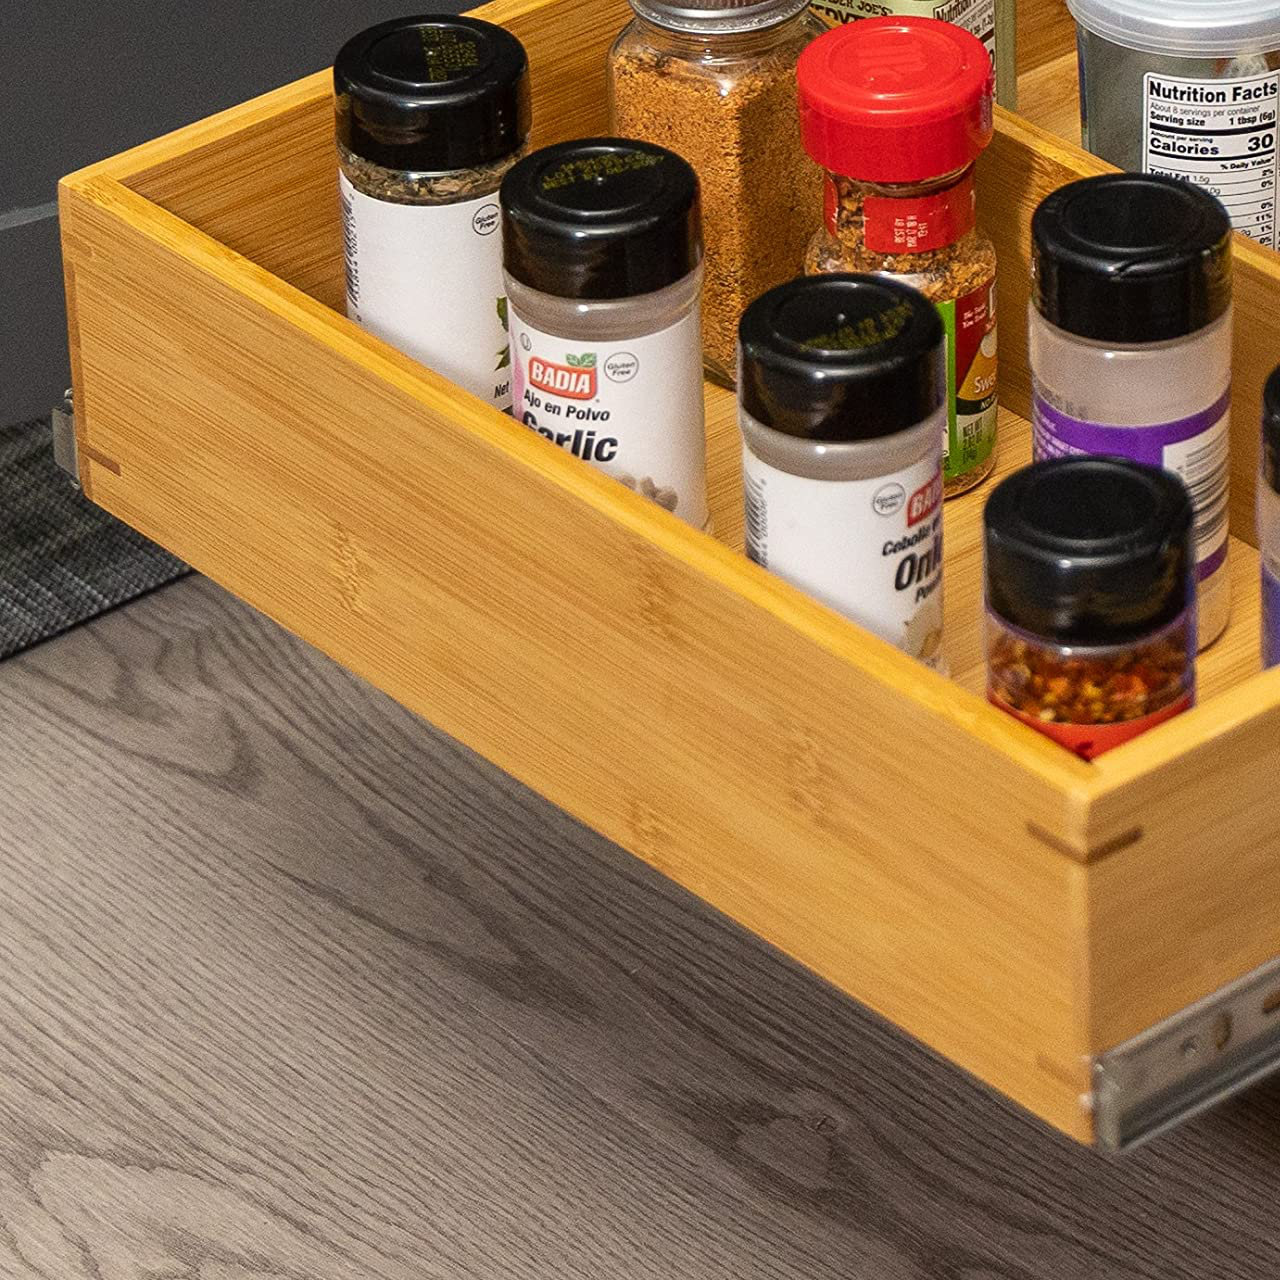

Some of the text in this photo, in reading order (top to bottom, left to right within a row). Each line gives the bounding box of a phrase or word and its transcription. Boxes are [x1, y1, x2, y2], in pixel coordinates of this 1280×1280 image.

[1149, 80, 1278, 103] Nutrition Facts
[1151, 102, 1261, 118] About servings per container
[1150, 111, 1184, 126] Serving
[1186, 116, 1206, 127] size
[1237, 114, 1257, 126] tbsp
[1150, 133, 1274, 155] Calories 30
[1151, 130, 1213, 144] Amount per serving
[1230, 160, 1249, 171] Daily
[1193, 175, 1210, 184] 1.5g
[479, 219, 495, 230] Free
[607, 361, 635, 371] Gluten
[612, 369, 631, 377] Free
[530, 360, 591, 394] BADIA
[494, 382, 510, 398] Net
[524, 389, 611, 421] Ajo en Polvo
